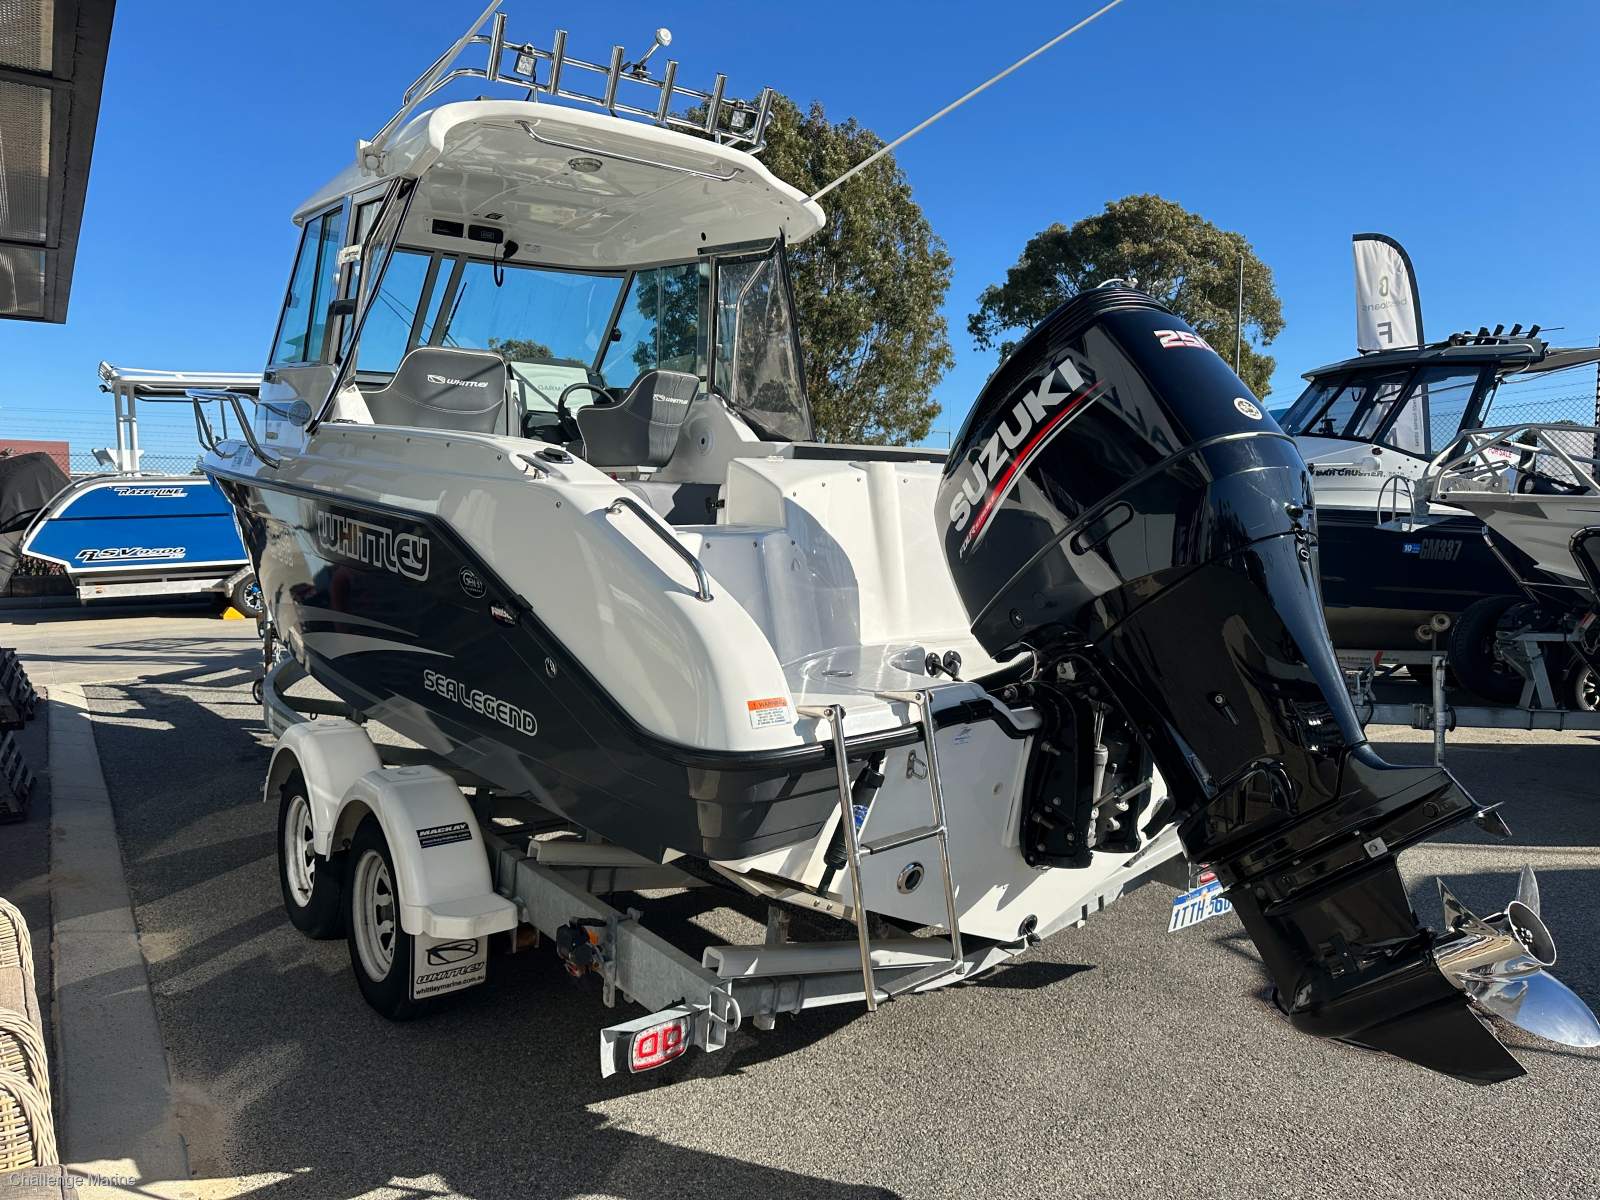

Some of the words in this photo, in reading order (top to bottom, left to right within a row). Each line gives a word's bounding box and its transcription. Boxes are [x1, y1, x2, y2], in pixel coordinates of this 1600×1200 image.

[950, 358, 1085, 532] SUZUKI
[317, 509, 430, 582] WHITTLEY
[423, 669, 458, 703] SEA
[458, 682, 538, 737] LEGEND
[415, 961, 486, 985] WHITTLEY
